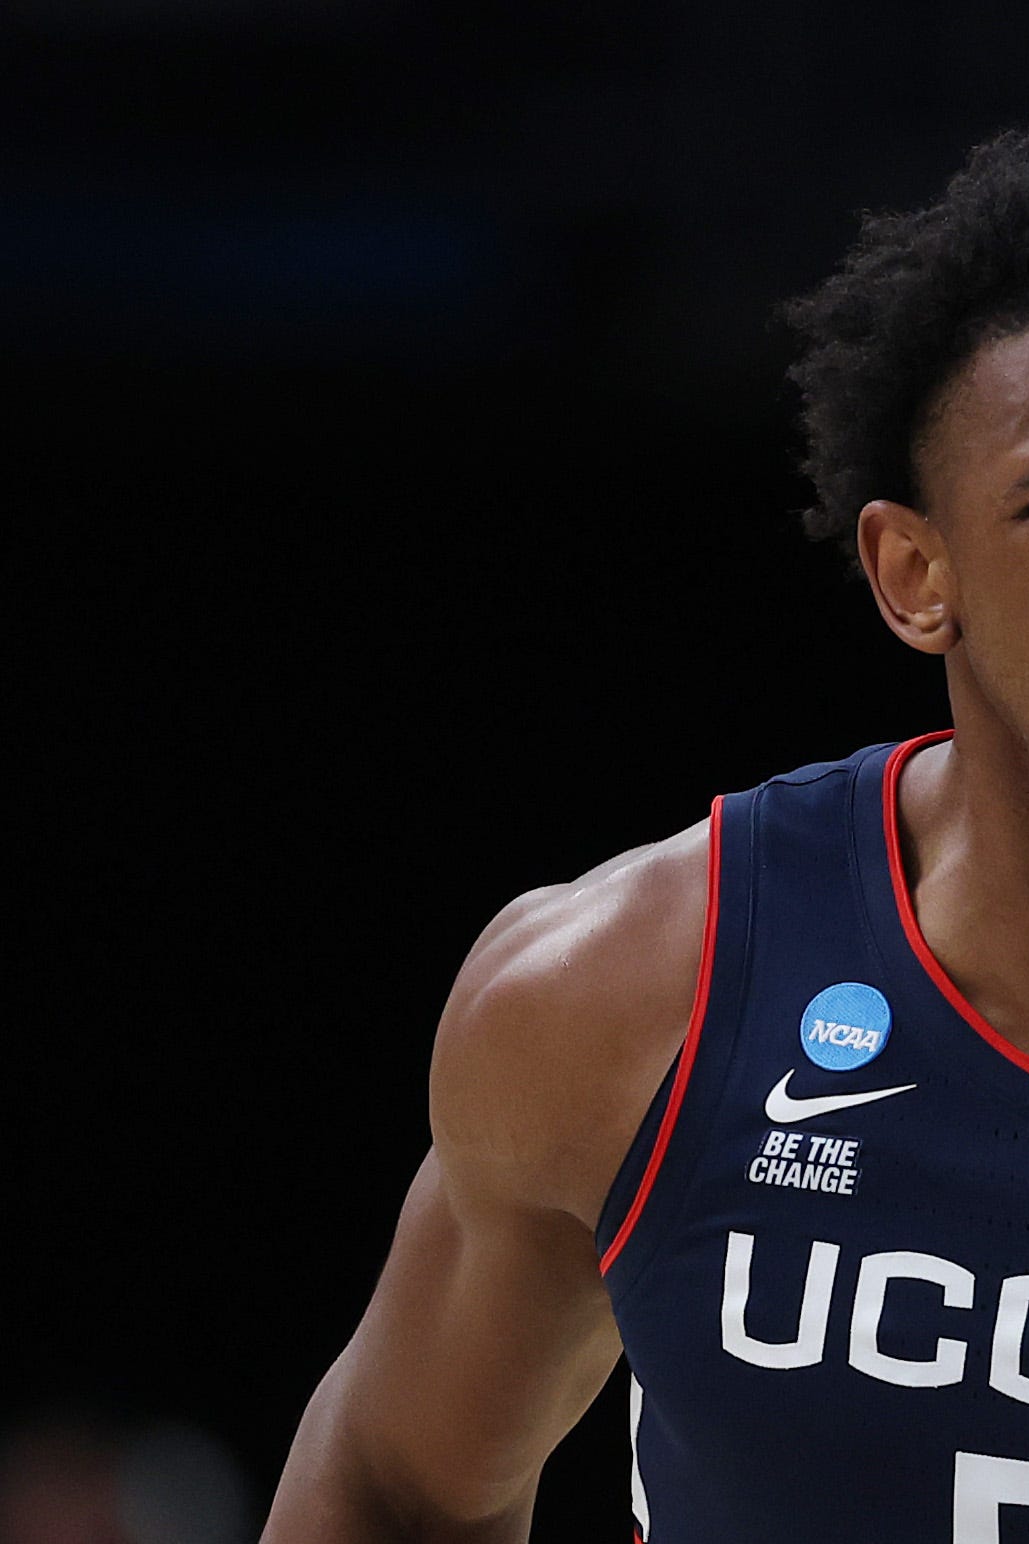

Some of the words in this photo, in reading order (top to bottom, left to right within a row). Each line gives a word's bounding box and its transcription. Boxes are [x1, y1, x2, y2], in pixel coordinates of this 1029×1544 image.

[809, 1019, 882, 1052] NCAA
[763, 1130, 803, 1159] BE
[808, 1136, 859, 1167] THE
[749, 1157, 858, 1195] CHANGE
